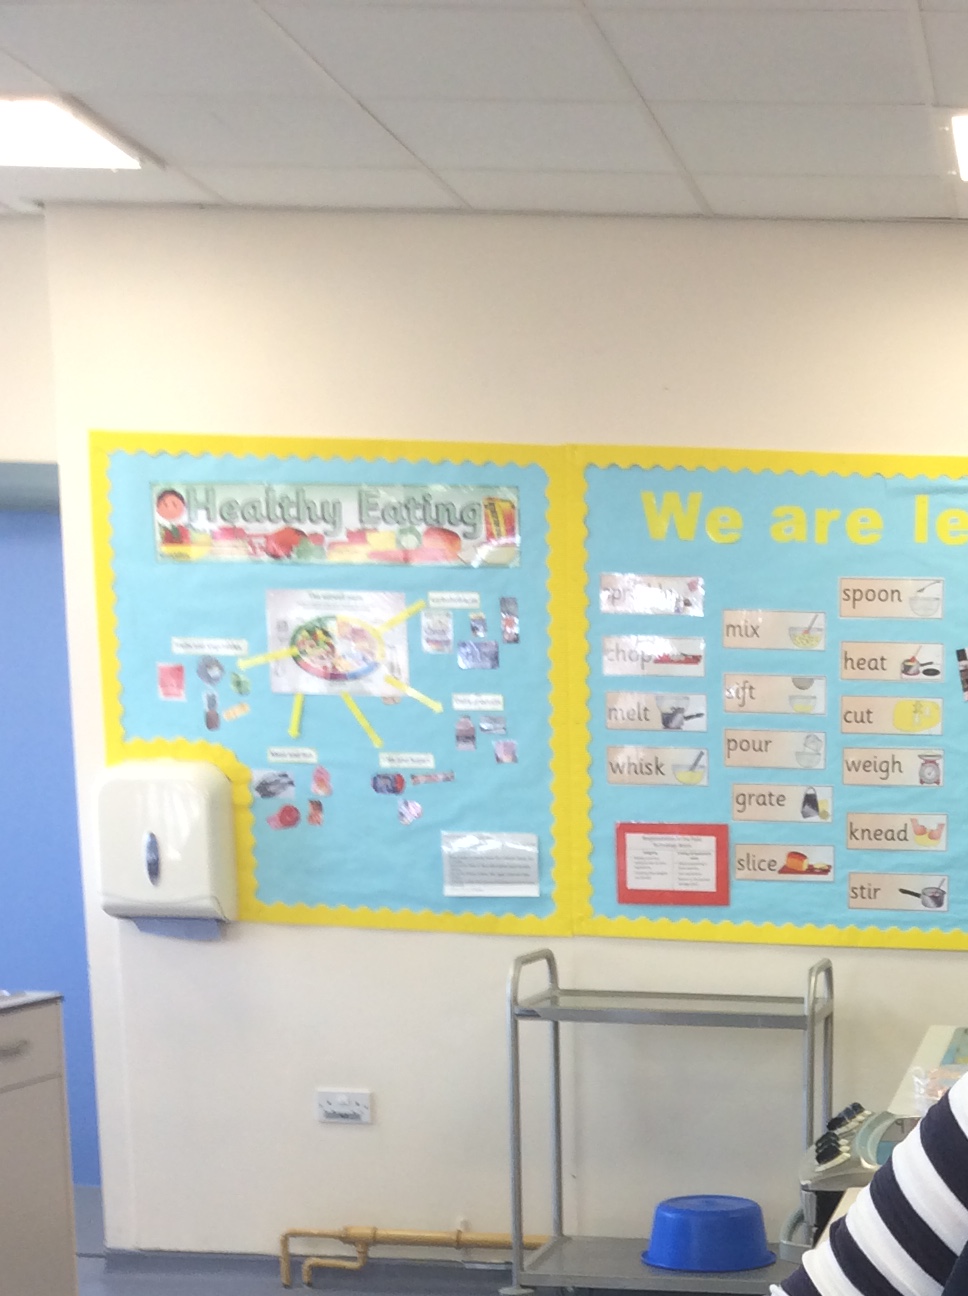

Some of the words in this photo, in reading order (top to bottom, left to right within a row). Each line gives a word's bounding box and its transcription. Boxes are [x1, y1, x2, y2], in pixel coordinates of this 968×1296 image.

[186, 485, 343, 537] Healthy
[357, 487, 483, 540] Eating
[640, 490, 744, 545] We
[769, 504, 885, 546] are
[842, 587, 903, 610] spoon
[725, 619, 760, 639] mix
[606, 641, 653, 670] chop
[843, 650, 887, 672] heat
[725, 680, 756, 708] sift
[607, 704, 650, 722] melt
[843, 709, 873, 724] cut
[726, 734, 772, 759] pour
[608, 756, 666, 777] whisk
[845, 754, 903, 781] weigh
[735, 790, 786, 813] grate
[849, 821, 909, 842] knead
[736, 850, 778, 873] slice
[850, 882, 881, 900] stir
